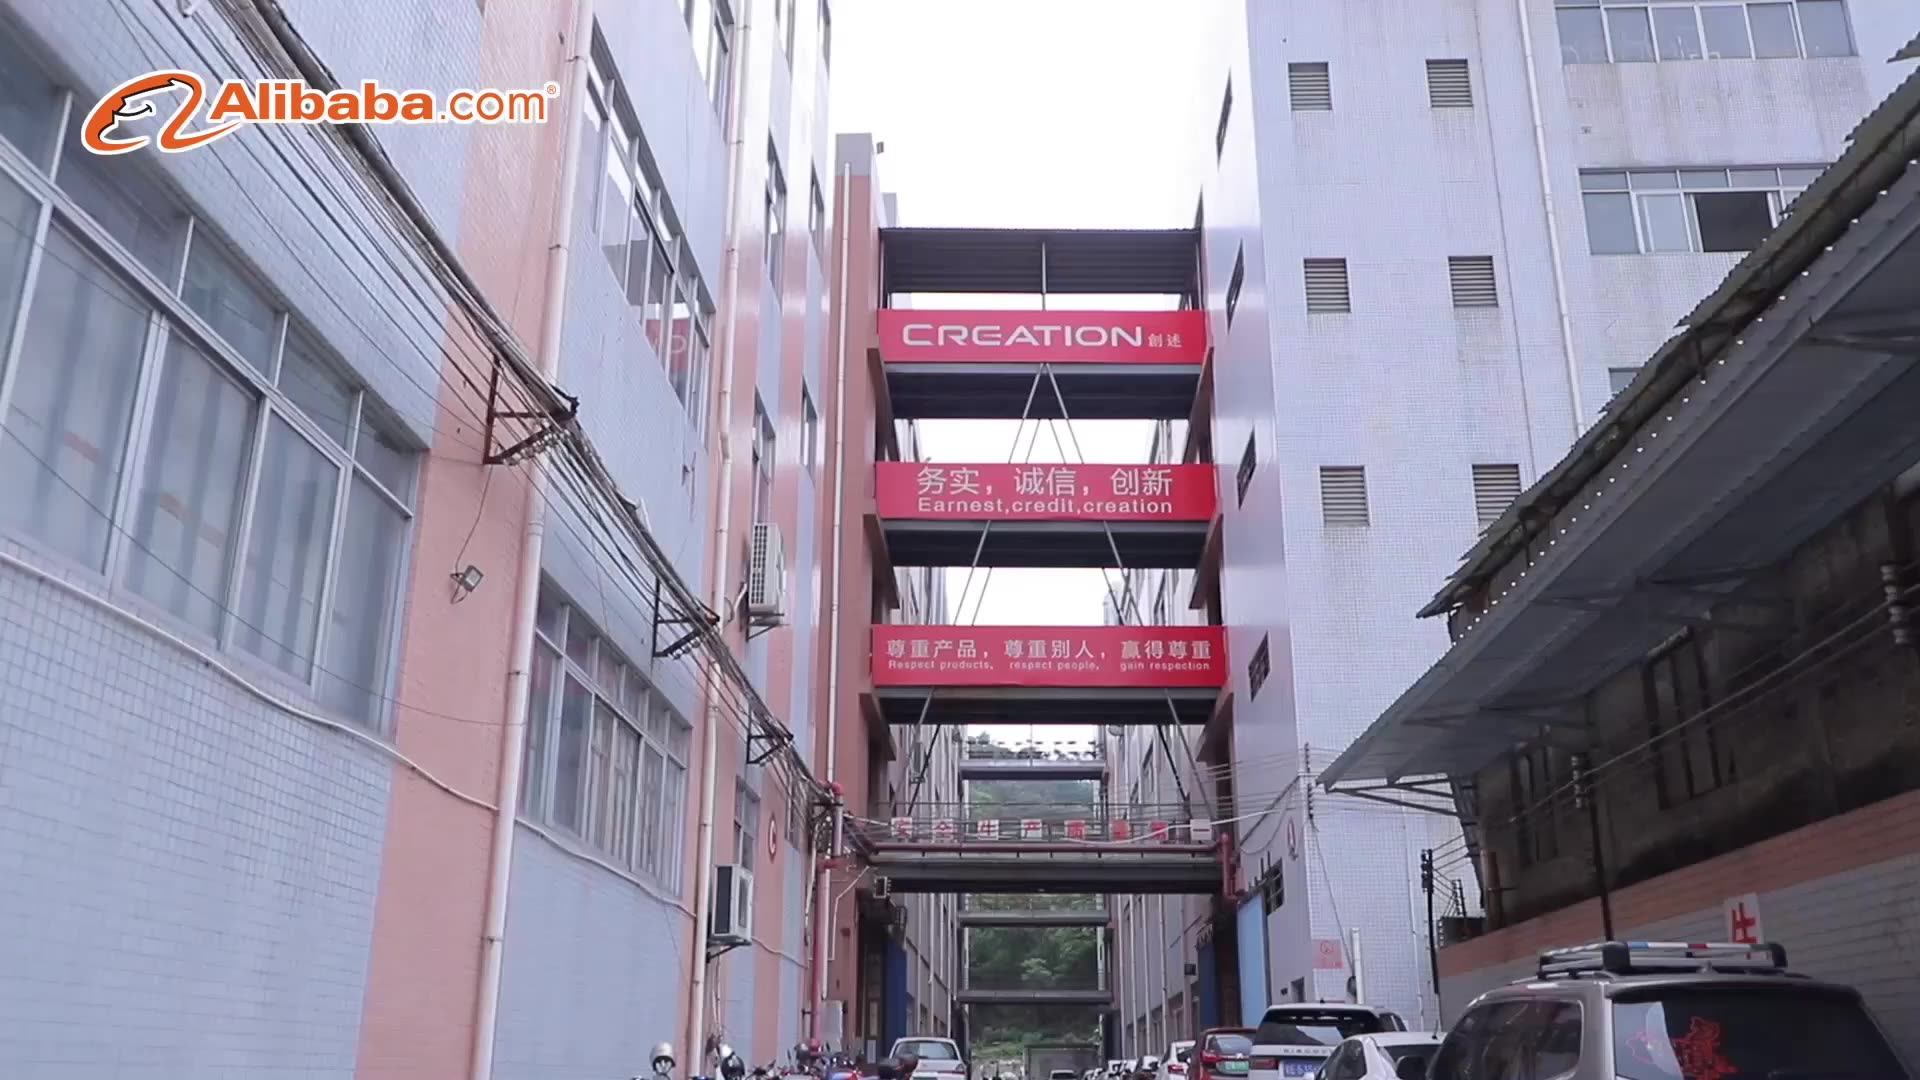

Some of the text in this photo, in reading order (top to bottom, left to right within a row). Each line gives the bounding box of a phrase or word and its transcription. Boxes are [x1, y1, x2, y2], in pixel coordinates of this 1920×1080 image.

[902, 324, 1142, 347] CREATION
[888, 660, 935, 671] Respect
[1009, 660, 1052, 671] respect
[1120, 661, 1145, 672] gain
